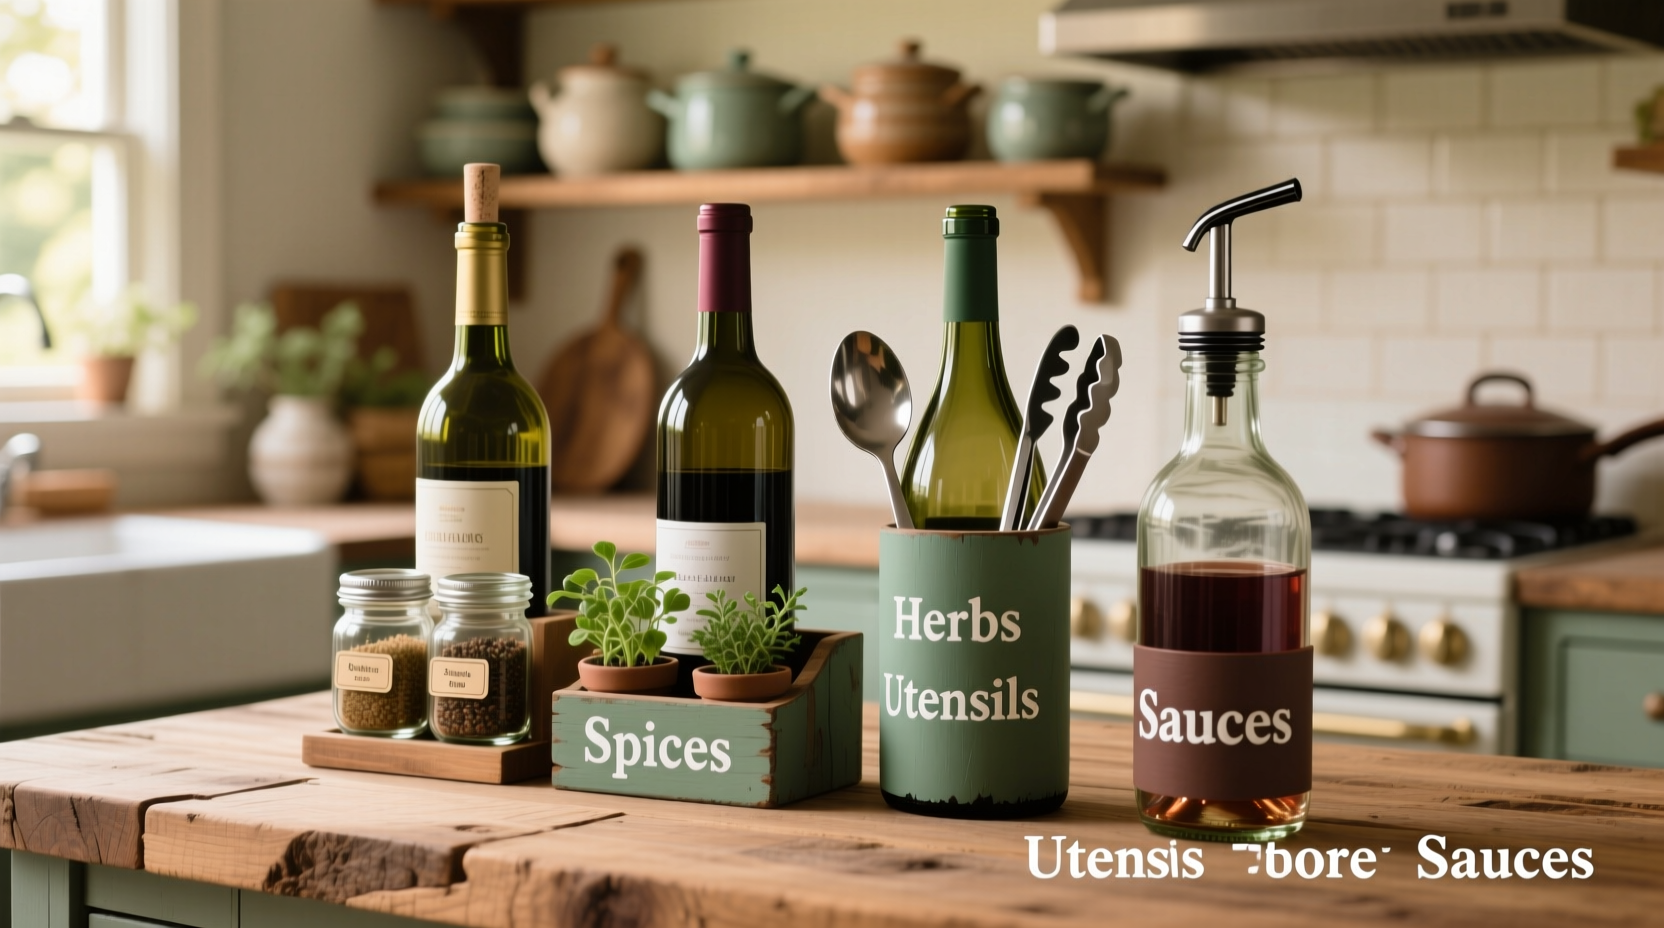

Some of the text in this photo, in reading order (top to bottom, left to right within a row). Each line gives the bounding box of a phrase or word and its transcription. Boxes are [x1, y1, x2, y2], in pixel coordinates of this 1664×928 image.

[893, 595, 1021, 643] Herbs
[884, 673, 1040, 722] Utensils
[1138, 688, 1293, 744] Sauces
[583, 715, 732, 780] Spices
